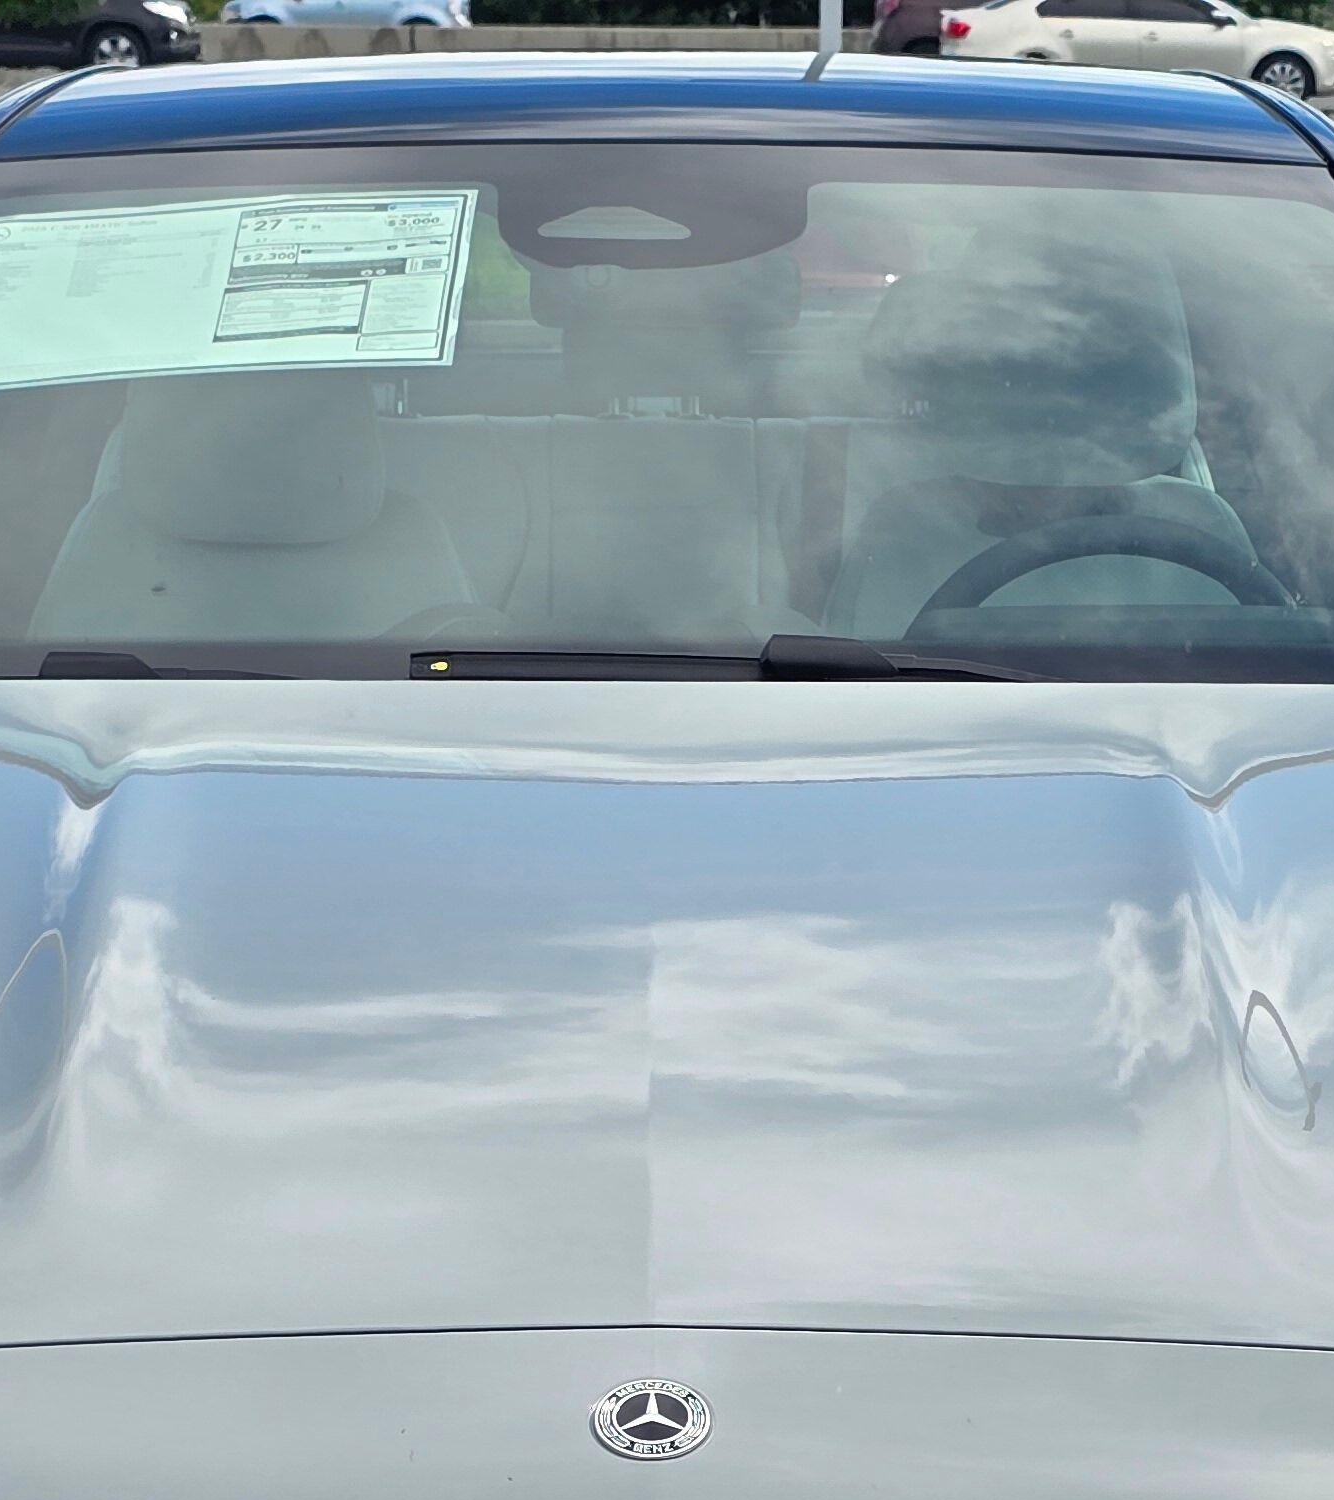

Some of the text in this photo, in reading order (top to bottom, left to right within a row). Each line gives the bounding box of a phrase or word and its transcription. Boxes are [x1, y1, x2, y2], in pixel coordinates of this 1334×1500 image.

[253, 218, 283, 232] 27
[387, 216, 440, 227] $3,000
[242, 251, 296, 263] $2,300
[615, 1382, 689, 1398] MERCEDES
[633, 1442, 674, 1454] BENZ
